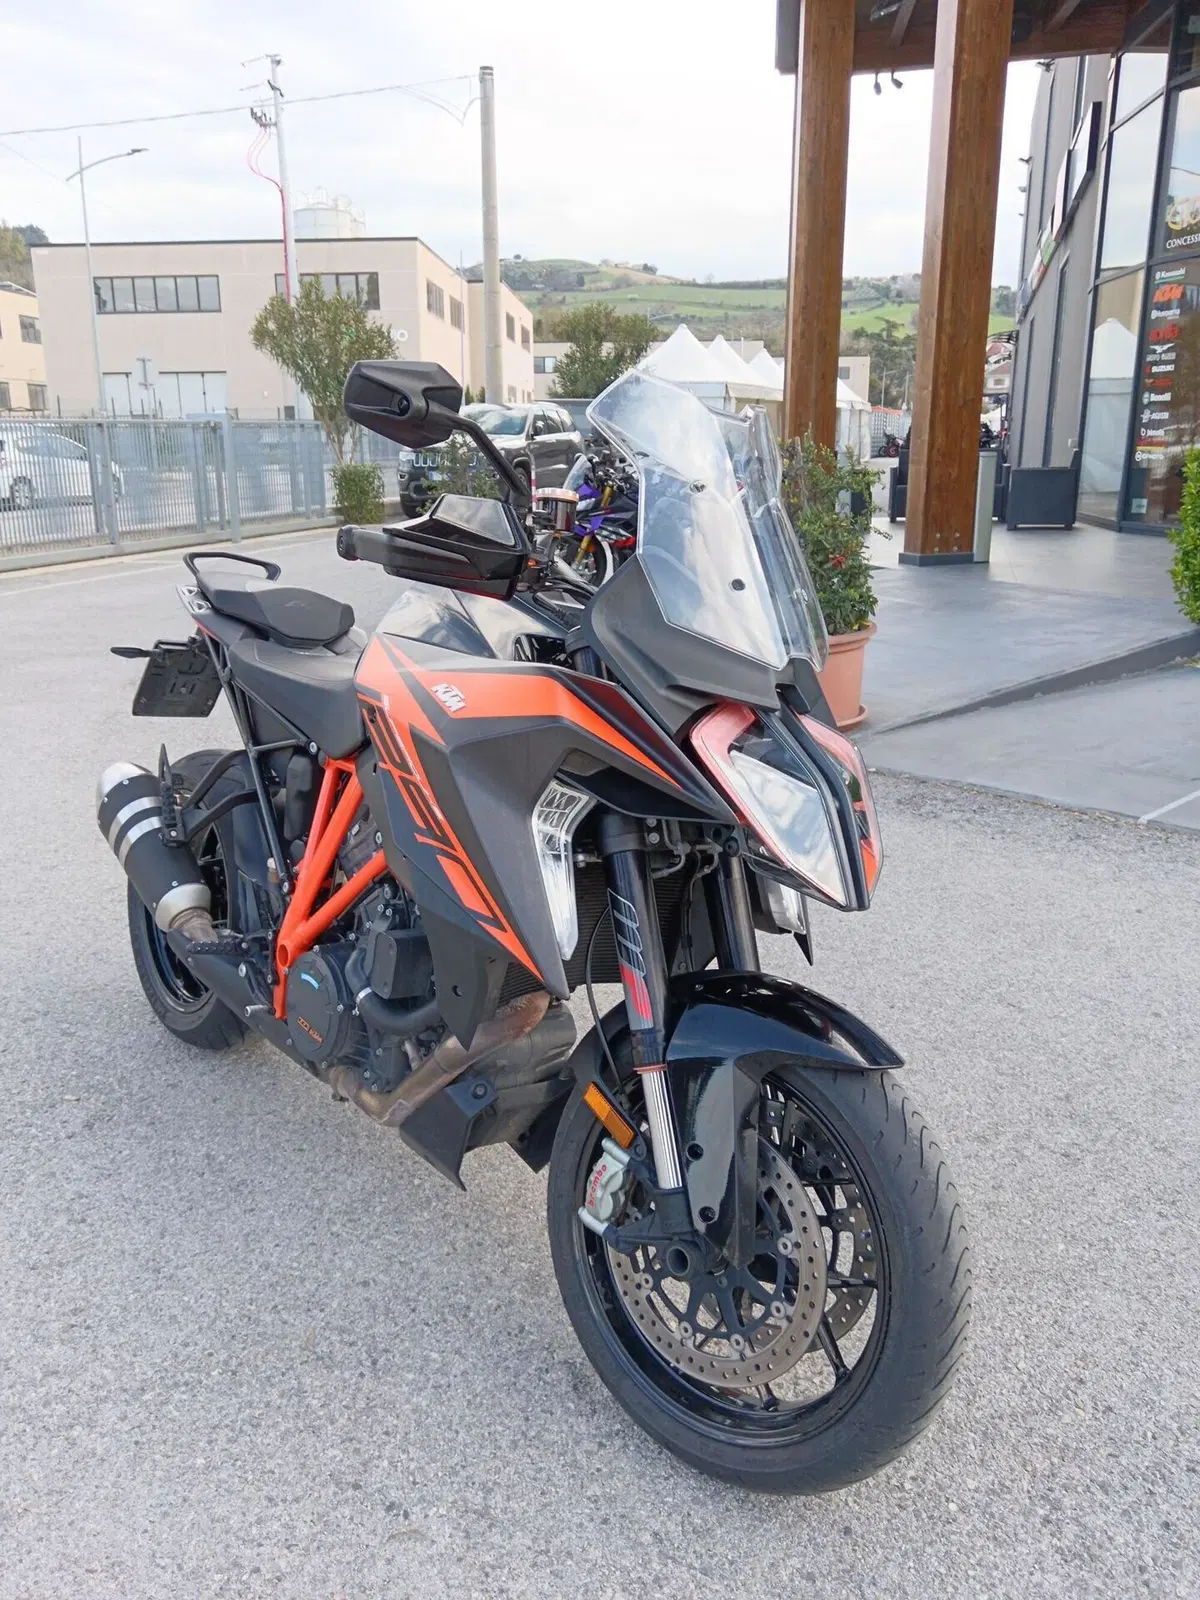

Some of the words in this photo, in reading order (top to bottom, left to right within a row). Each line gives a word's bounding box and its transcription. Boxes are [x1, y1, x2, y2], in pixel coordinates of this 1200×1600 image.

[1153, 284, 1185, 303] KTM
[430, 682, 467, 713] KTM
[587, 1164, 607, 1207] brembo
